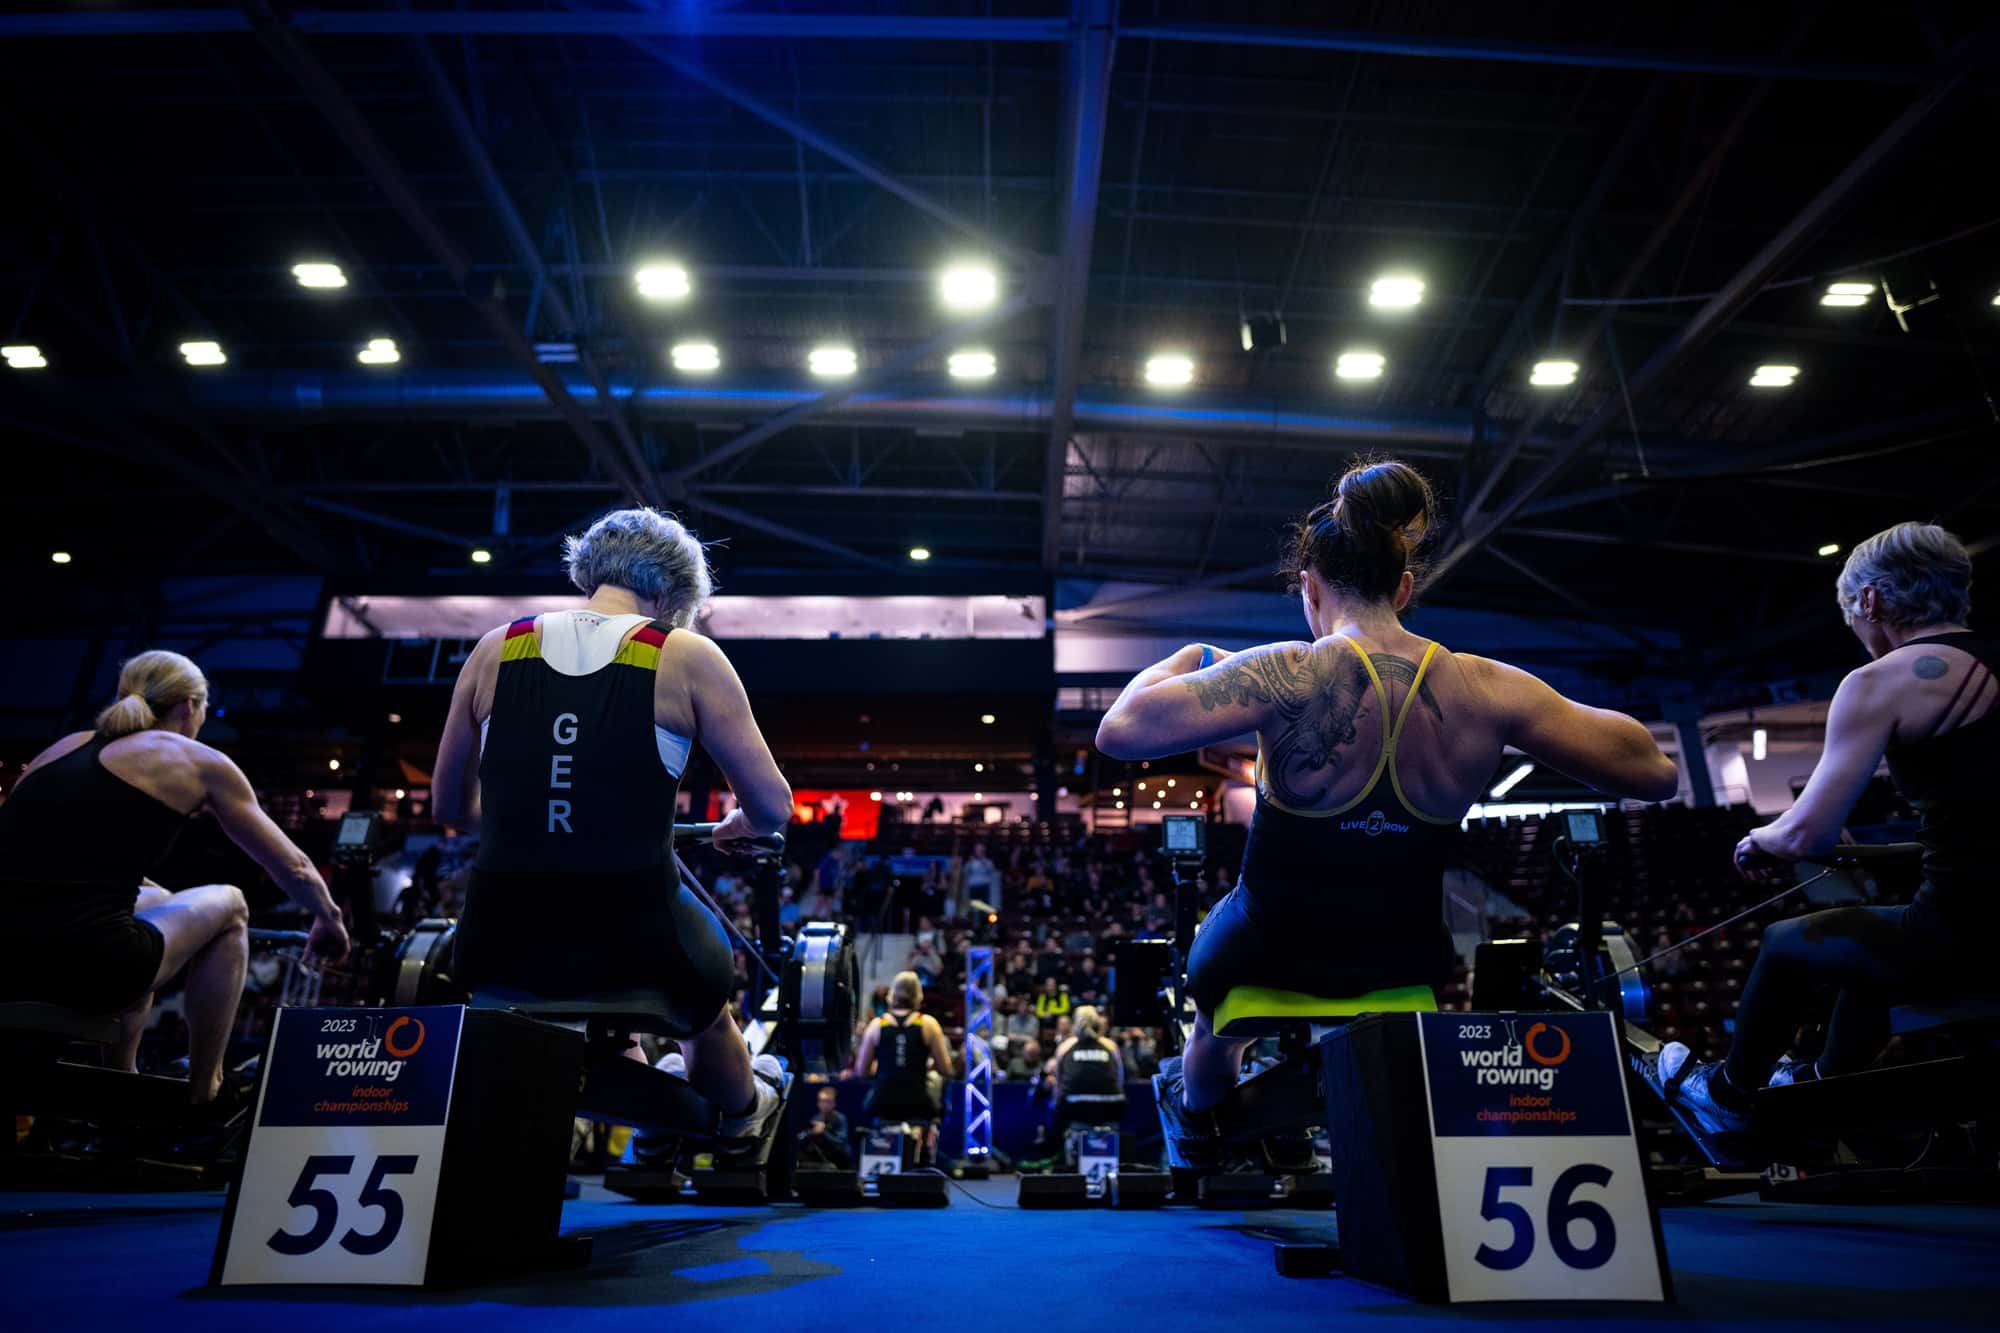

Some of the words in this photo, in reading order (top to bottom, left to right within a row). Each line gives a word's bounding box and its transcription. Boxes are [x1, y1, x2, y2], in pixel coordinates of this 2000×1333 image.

[548, 713, 579, 833] GER
[320, 1019, 357, 1033] 2023
[1458, 1025, 1492, 1039] 2023
[316, 1039, 382, 1059] world
[1461, 1045, 1522, 1067] world
[325, 1060, 403, 1082] rowing
[1477, 1068, 1555, 1090] rowing
[352, 1085, 393, 1098] indoor
[1509, 1095, 1552, 1107] indoor
[313, 1100, 409, 1114] championships
[1476, 1109, 1577, 1124] championships
[266, 1155, 419, 1256] 55
[1474, 1163, 1617, 1271] 56
